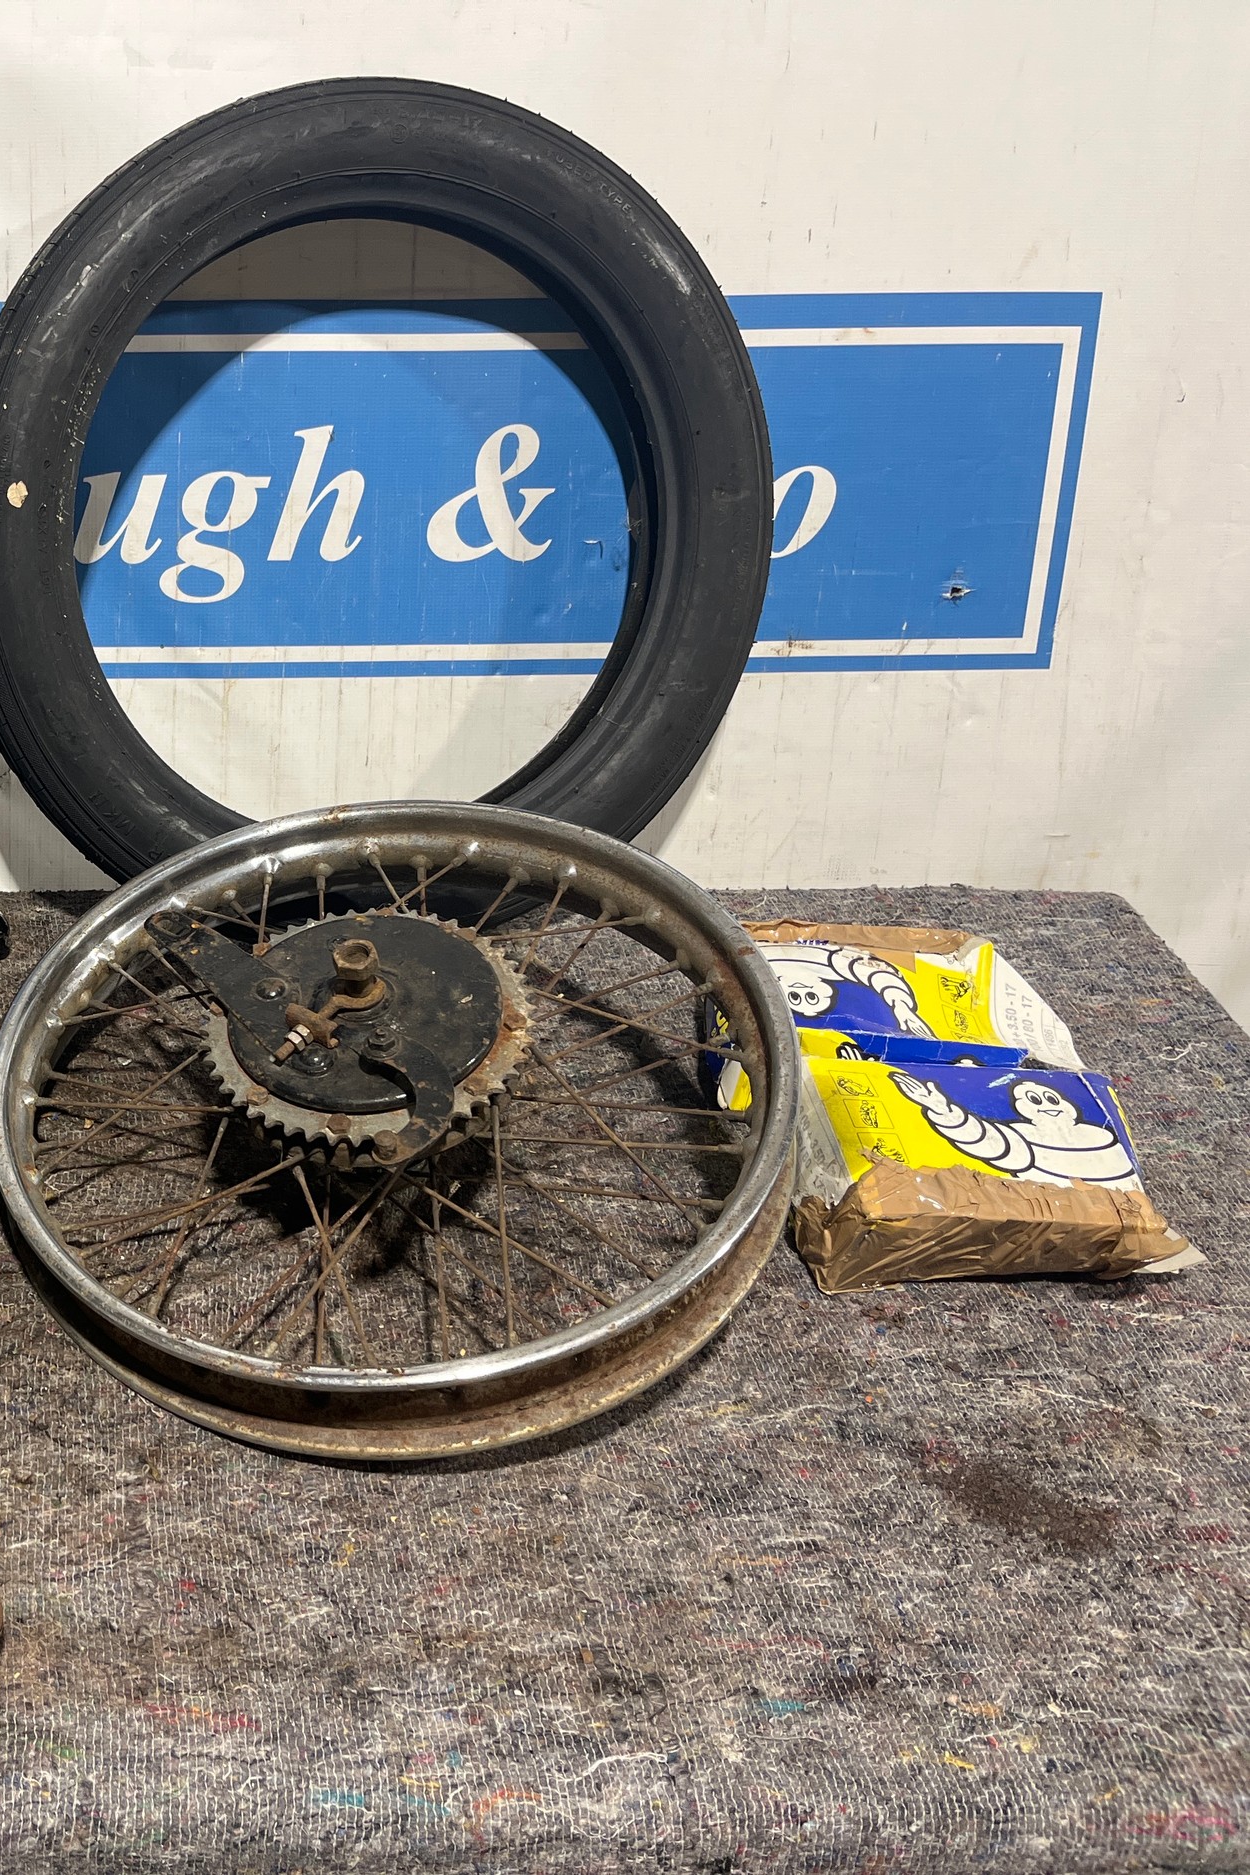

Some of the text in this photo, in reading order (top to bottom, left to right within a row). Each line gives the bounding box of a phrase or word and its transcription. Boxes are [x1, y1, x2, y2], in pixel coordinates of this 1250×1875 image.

[596, 181, 633, 215] TYPE
[75, 423, 364, 603] ugh
[425, 422, 555, 563] &
[771, 464, 837, 558] o
[1005, 983, 1017, 997] 17
[1022, 995, 1033, 1008] 17
